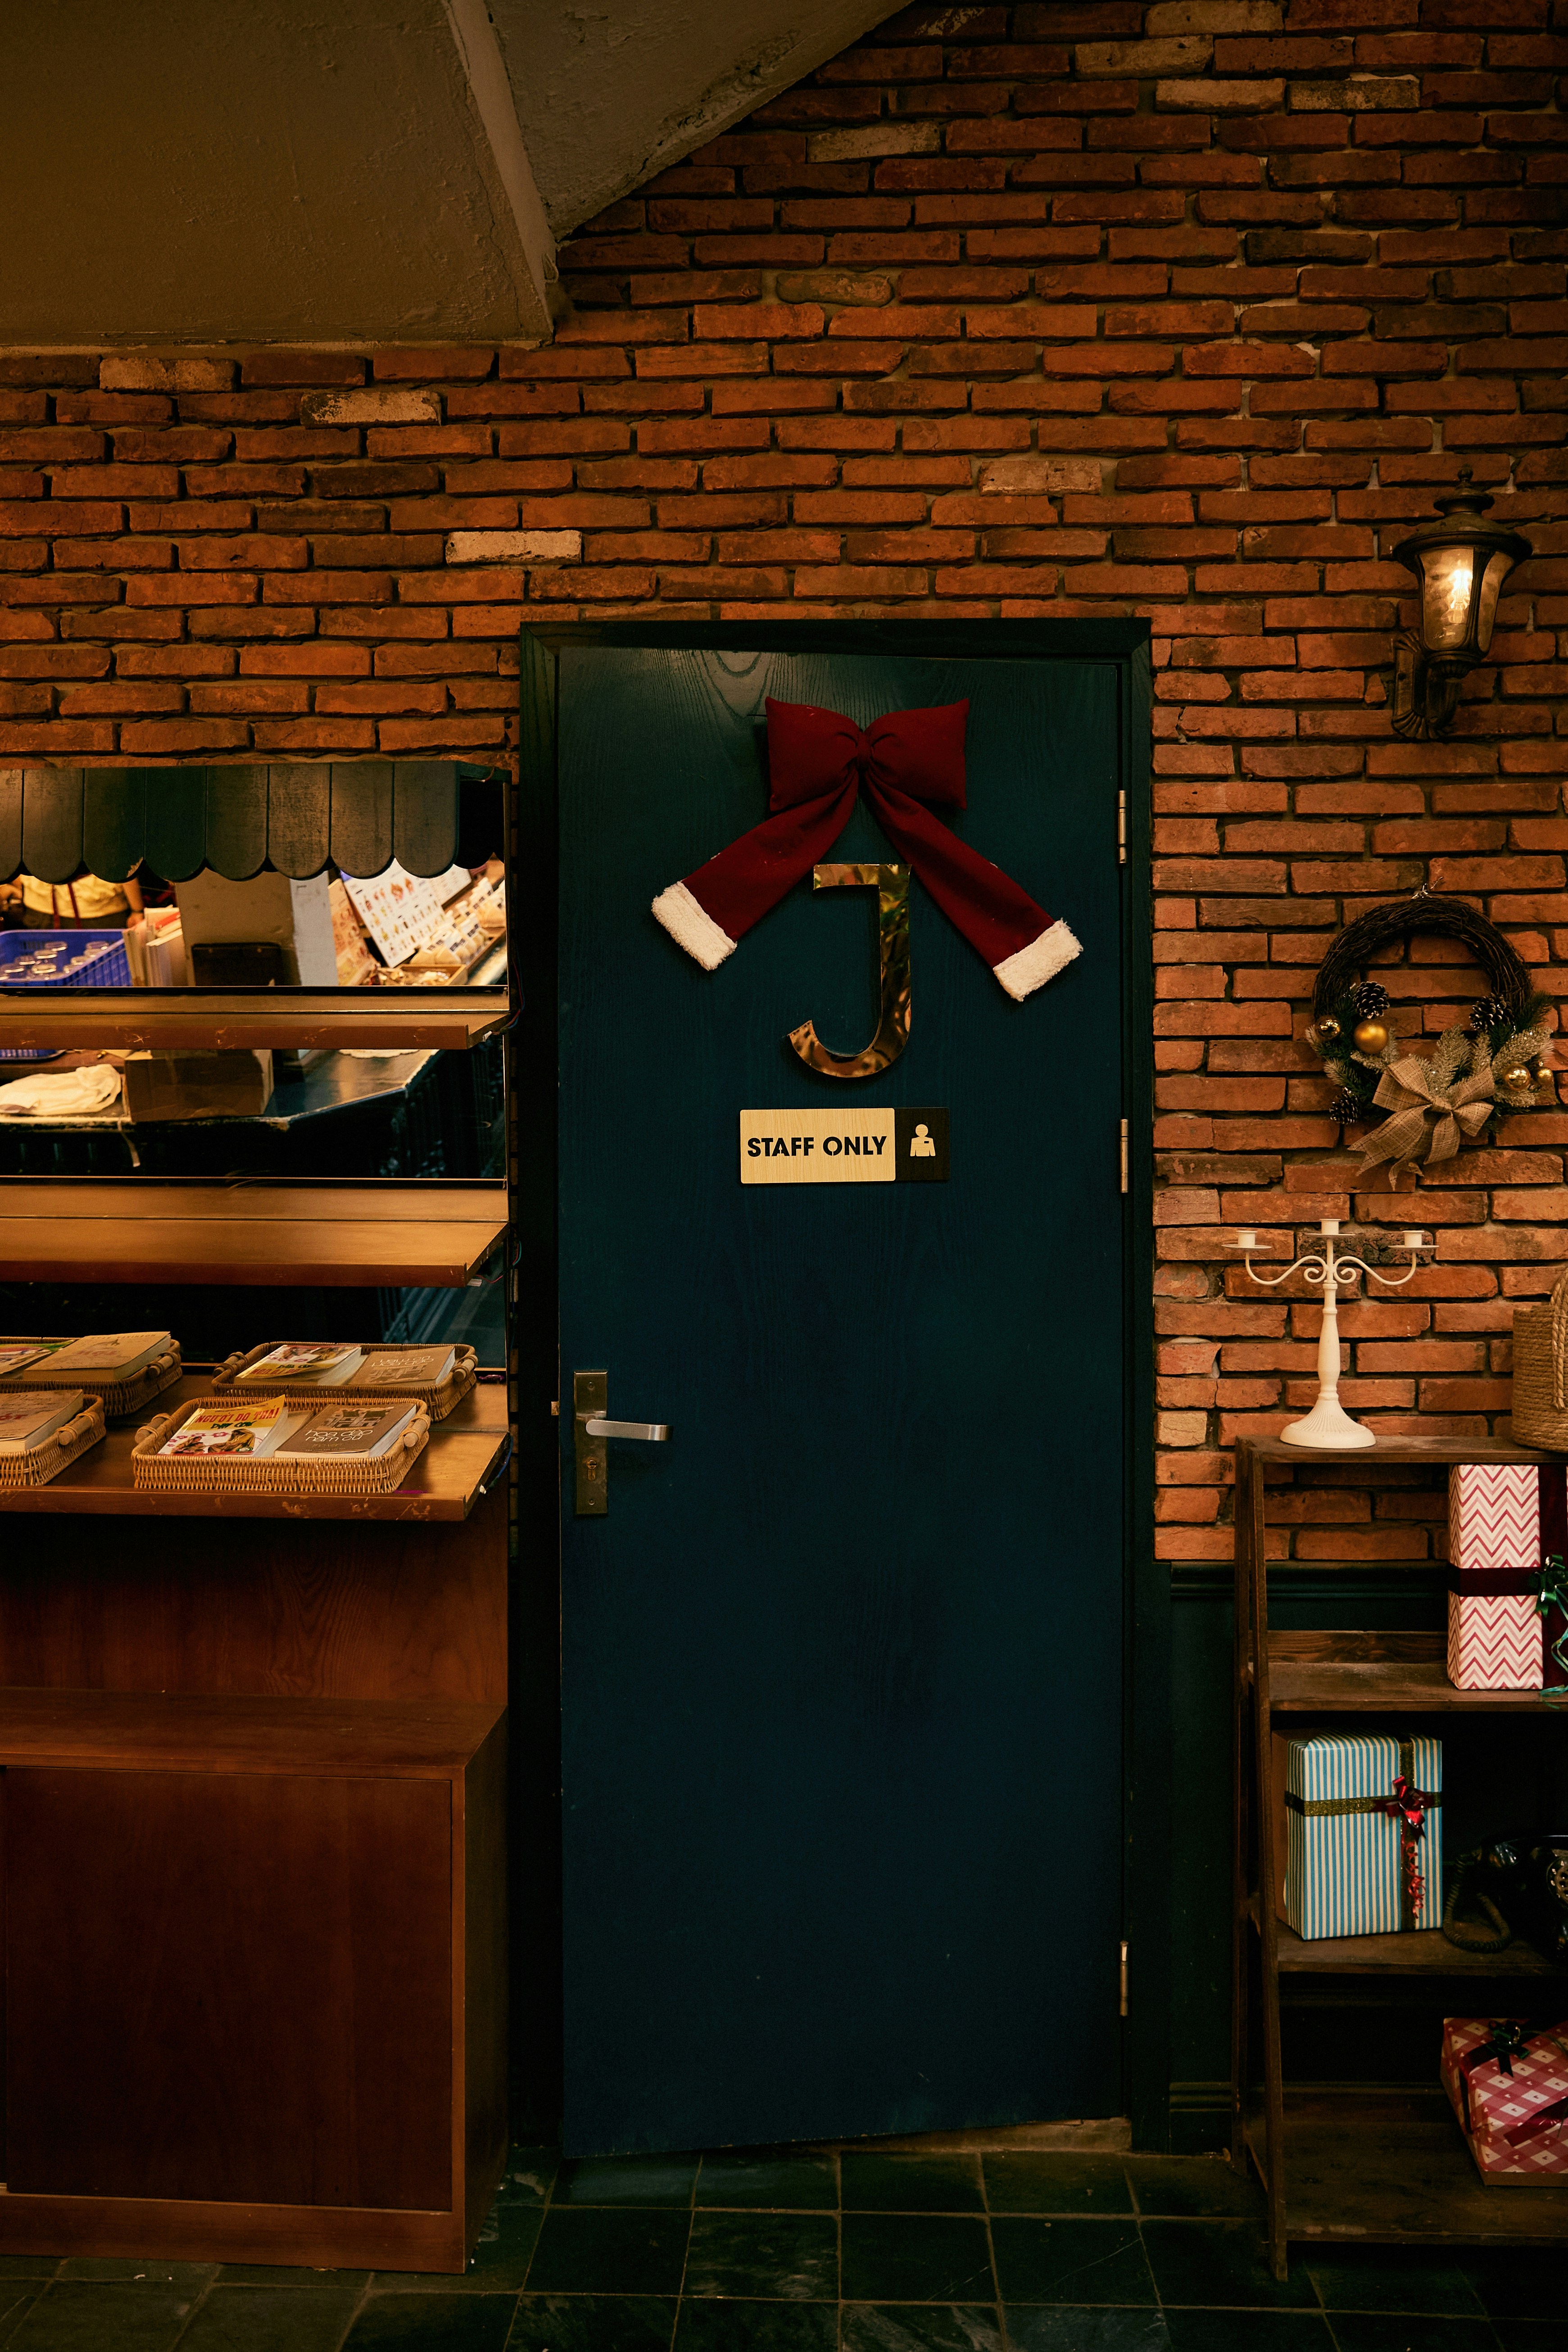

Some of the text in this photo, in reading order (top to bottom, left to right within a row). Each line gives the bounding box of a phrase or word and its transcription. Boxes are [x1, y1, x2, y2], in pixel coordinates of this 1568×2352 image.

[787, 864, 912, 1078] J
[747, 1136, 887, 1157] STAFF ONLY
[234, 1412, 251, 1422] DO
[253, 1405, 280, 1420] THÁI
